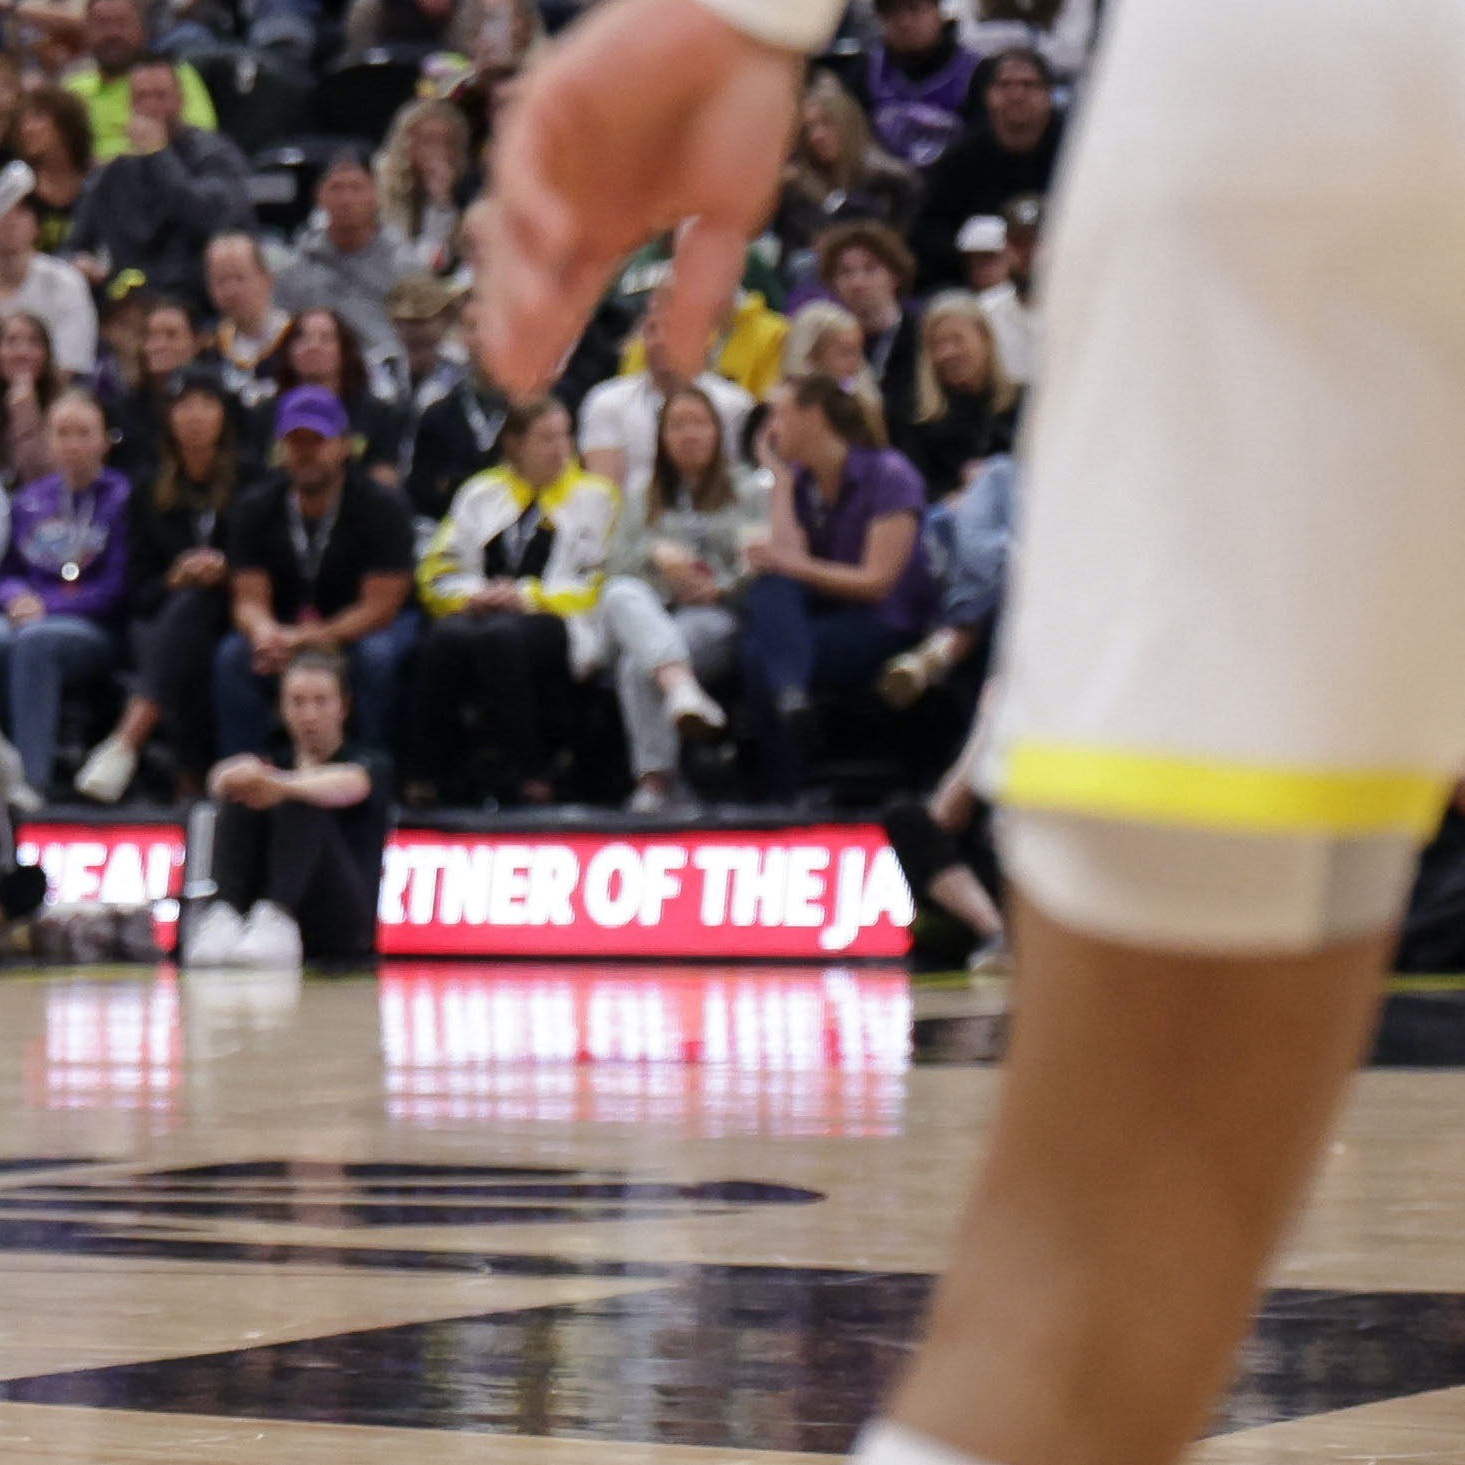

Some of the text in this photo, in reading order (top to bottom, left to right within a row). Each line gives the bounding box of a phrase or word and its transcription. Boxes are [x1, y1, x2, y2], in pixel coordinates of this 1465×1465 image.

[583, 842, 689, 928] OF
[693, 845, 821, 927] THE
[818, 845, 916, 950] JA
